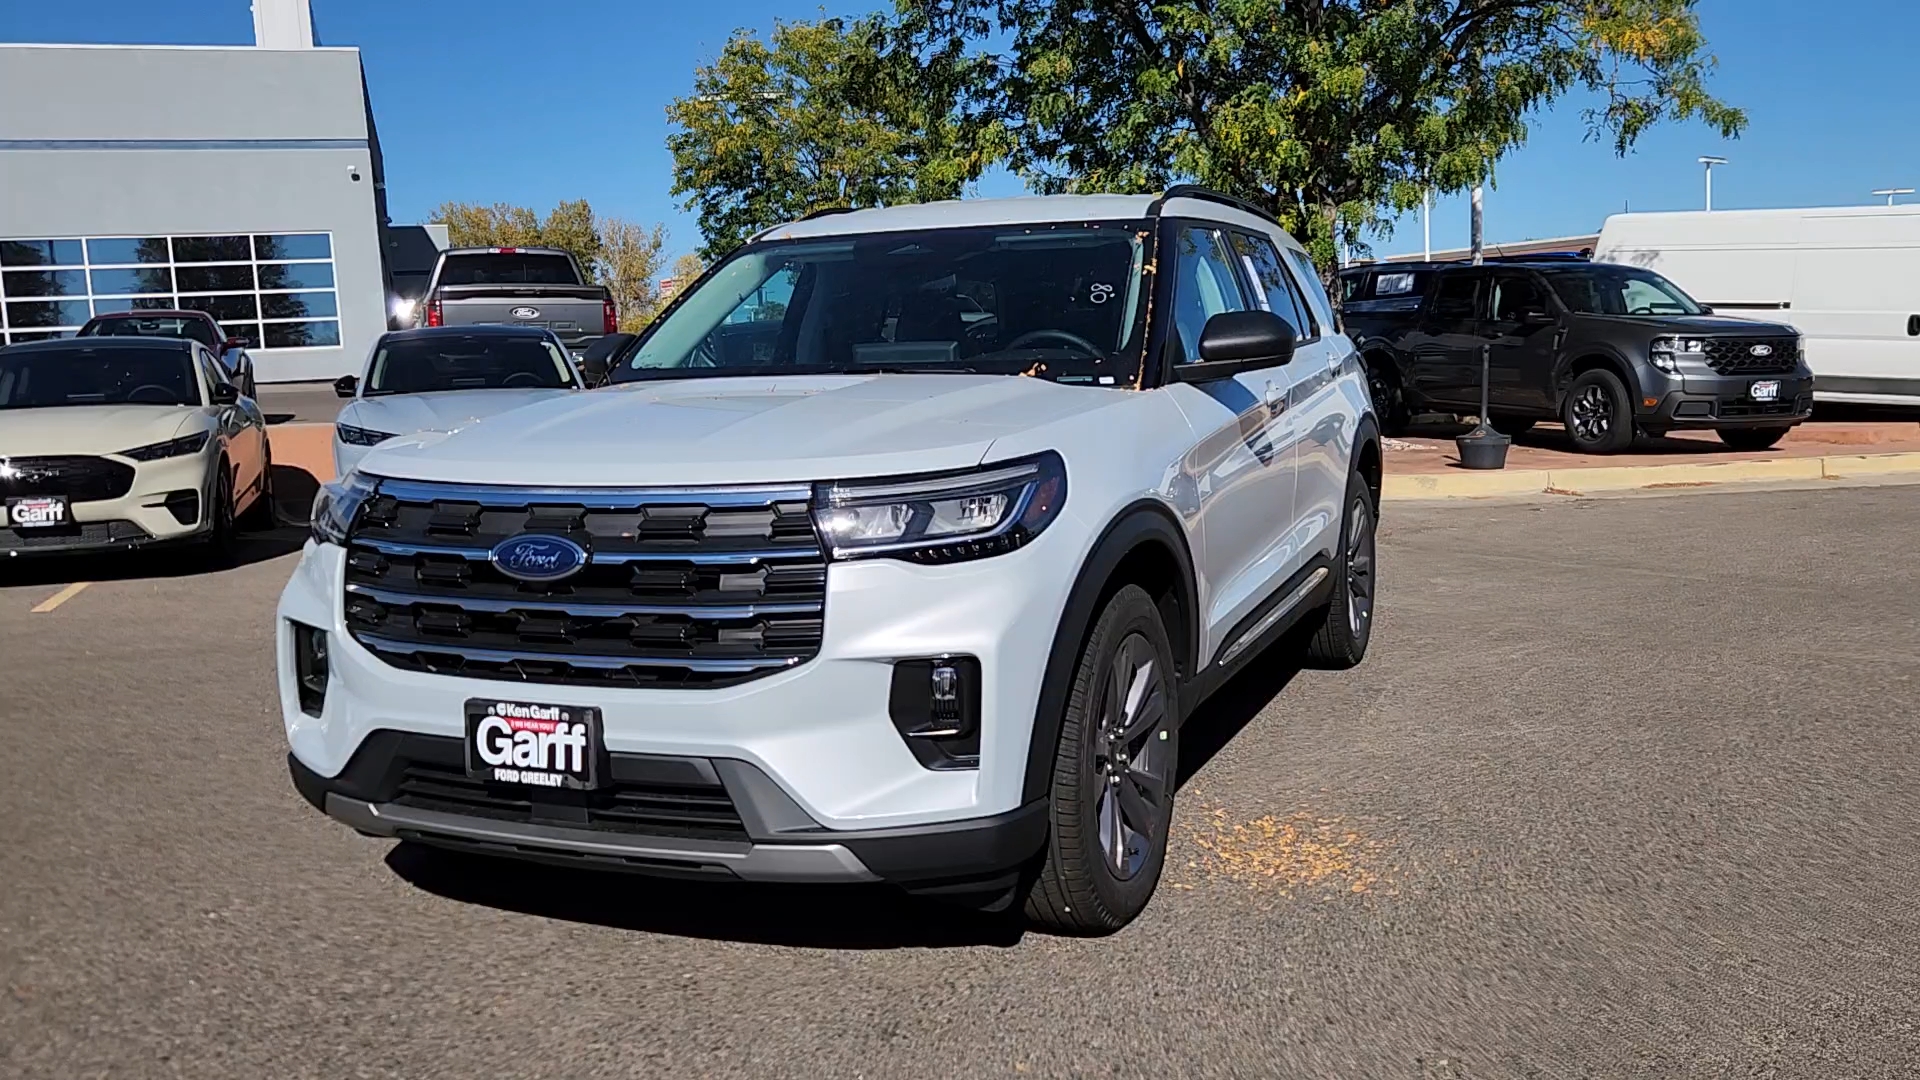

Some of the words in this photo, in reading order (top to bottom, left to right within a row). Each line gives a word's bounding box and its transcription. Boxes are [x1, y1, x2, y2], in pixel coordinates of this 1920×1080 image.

[12, 502, 64, 522] Garff
[510, 543, 561, 569] Ford
[507, 704, 529, 718] Ken
[530, 705, 559, 720] Garff
[477, 715, 586, 772] Garff
[494, 768, 519, 782] FORD
[520, 771, 563, 787] GREELEY
